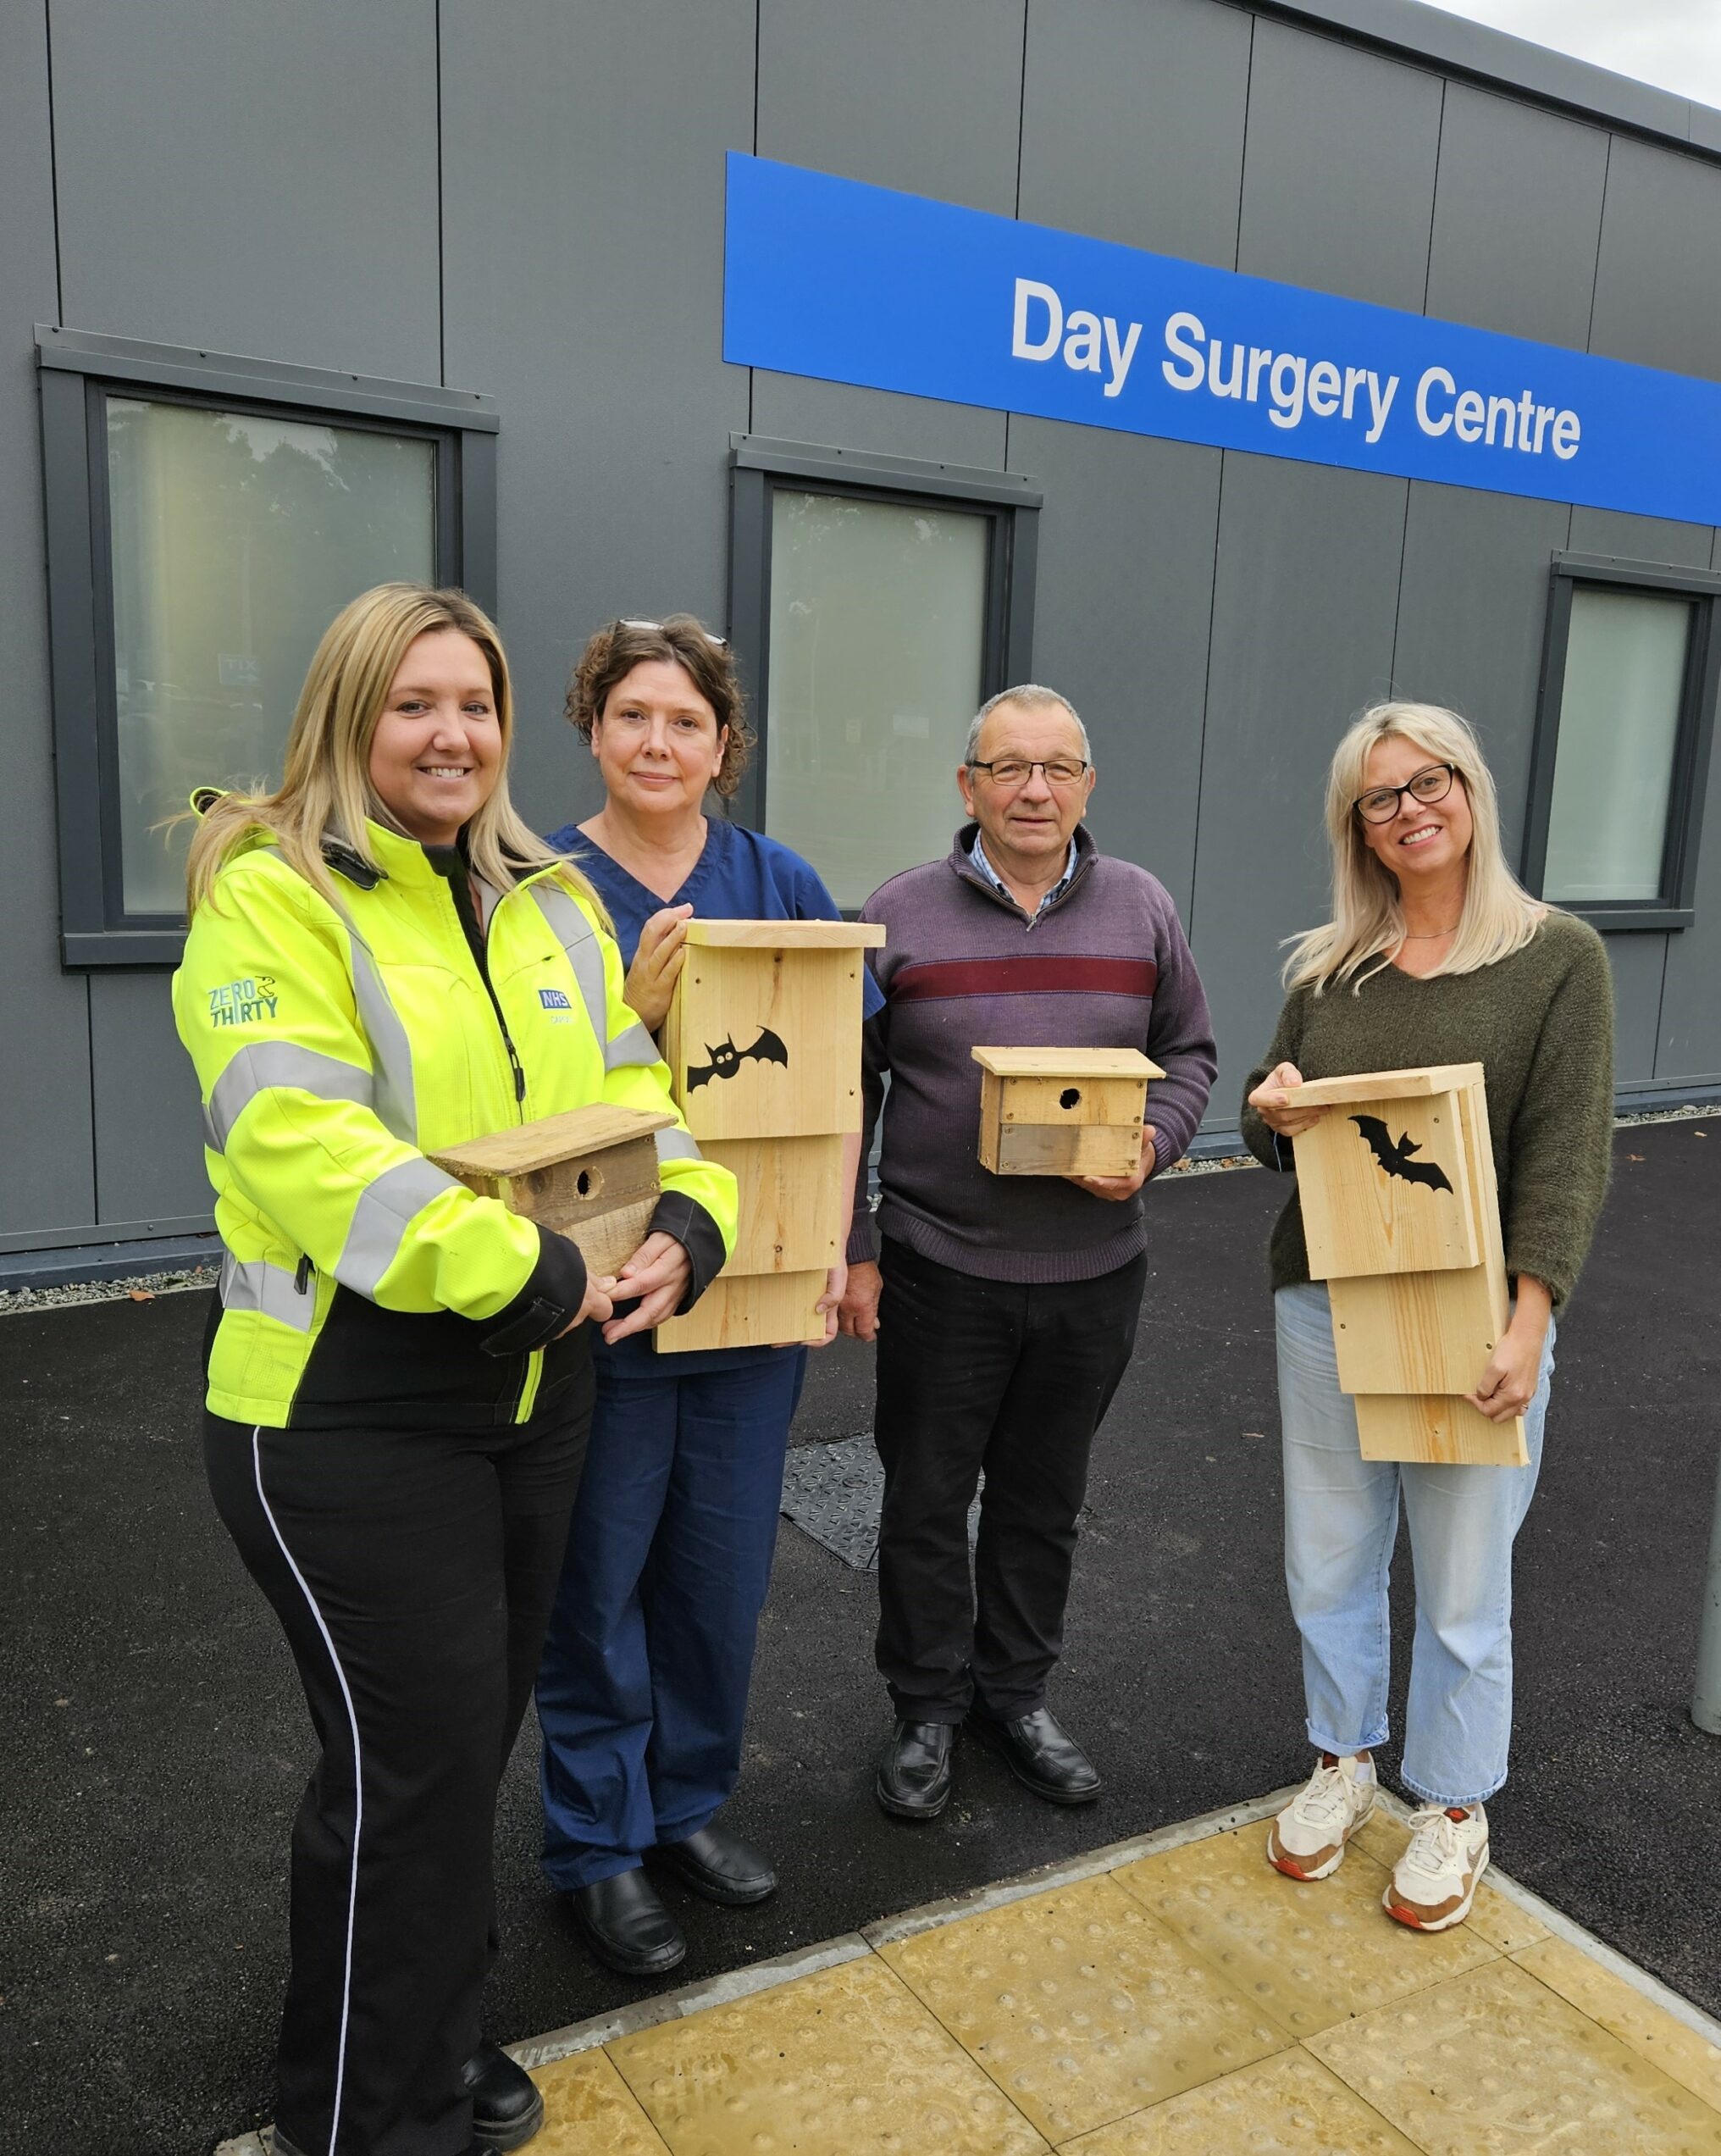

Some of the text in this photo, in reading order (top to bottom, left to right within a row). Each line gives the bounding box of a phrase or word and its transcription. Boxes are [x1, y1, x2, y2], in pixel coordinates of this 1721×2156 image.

[1011, 277, 1581, 460] Day Surgery Centre
[208, 979, 256, 1010] ZERO
[542, 990, 569, 1007] NHS
[210, 996, 279, 1028] THIRTY
